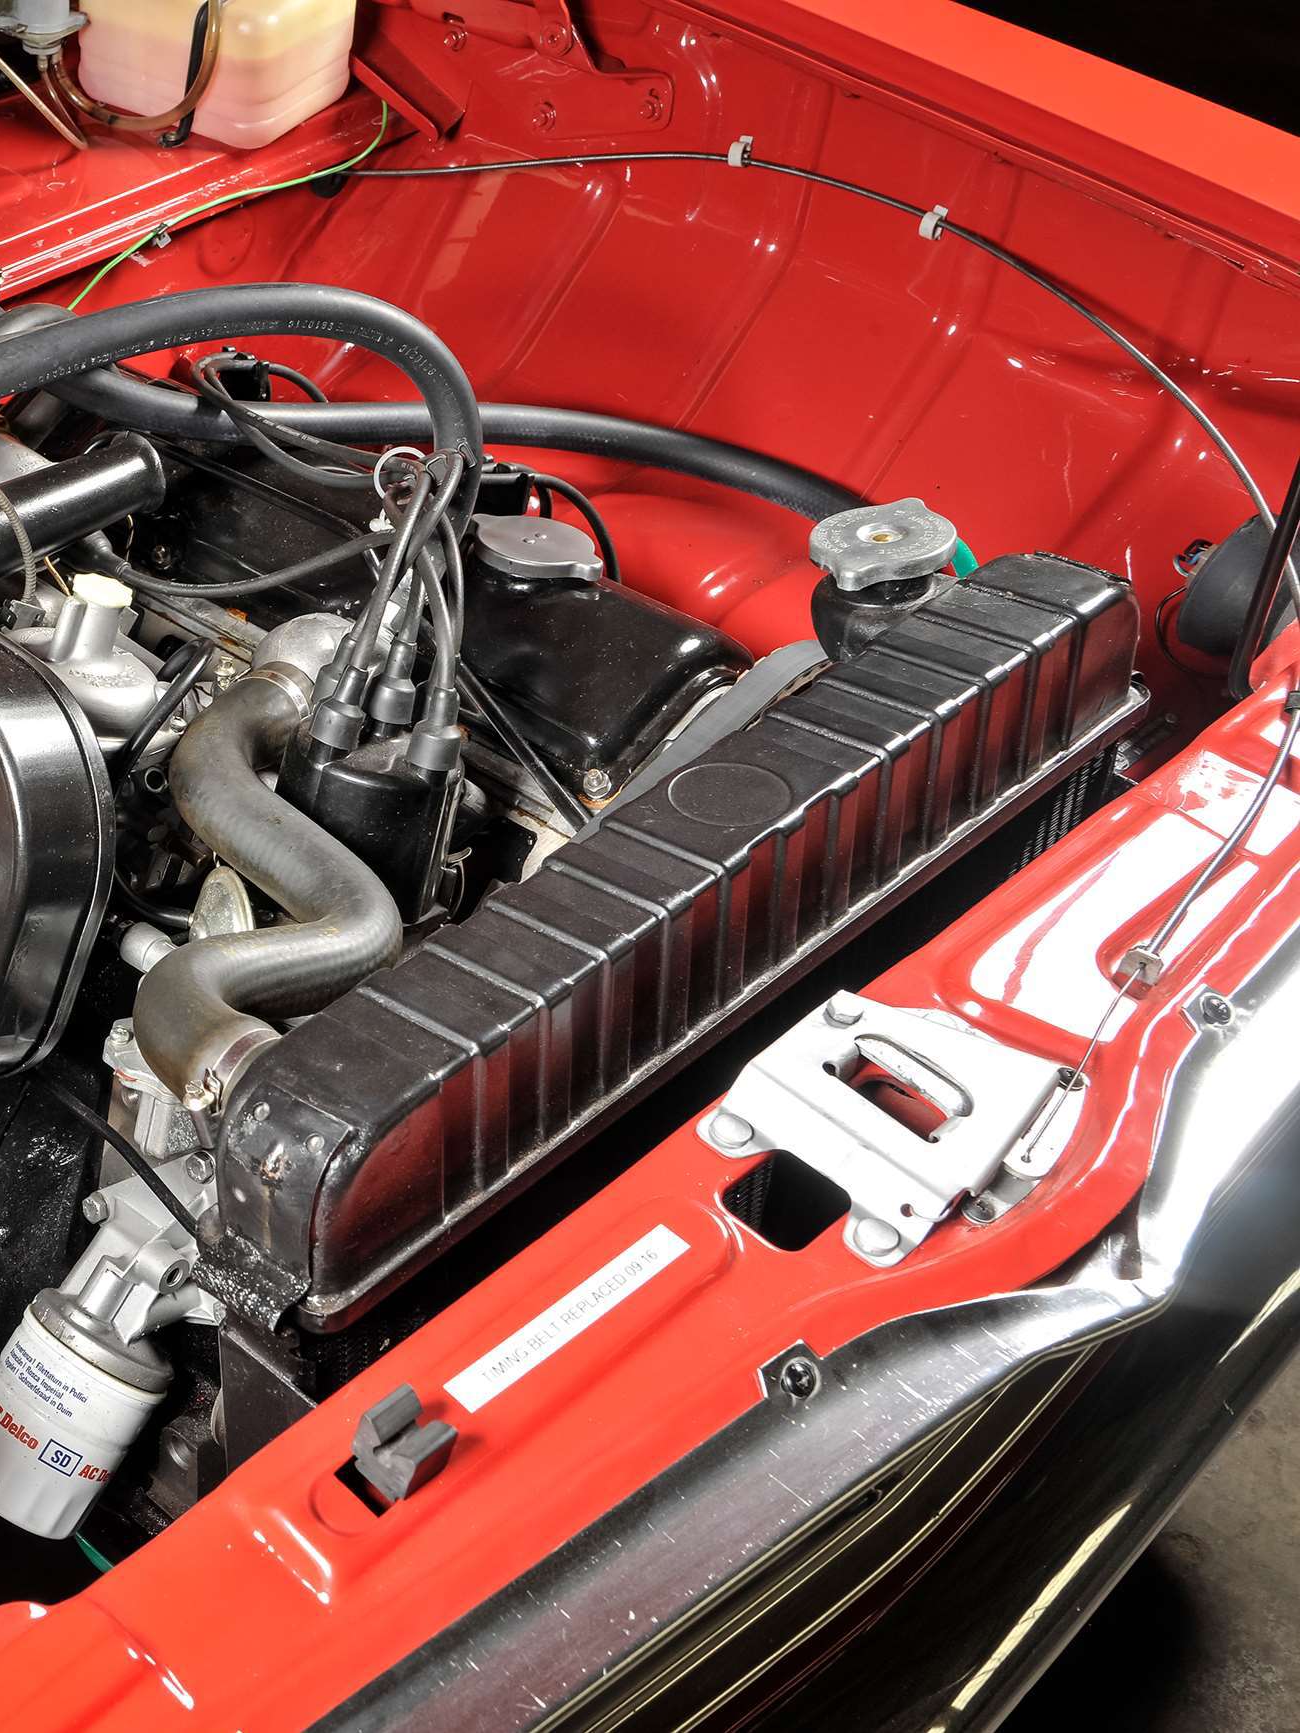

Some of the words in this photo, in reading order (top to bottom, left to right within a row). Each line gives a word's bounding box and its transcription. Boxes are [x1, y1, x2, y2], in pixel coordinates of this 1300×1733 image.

[481, 1349, 528, 1384] TIMING
[526, 1322, 562, 1351] BELT
[560, 1274, 627, 1324] REPLACED
[25, 1366, 41, 1382] Rosca
[40, 1379, 64, 1400] Imperial
[56, 1402, 73, 1418] Duim
[0, 1412, 39, 1450] Delco
[50, 1449, 72, 1468] SD
[78, 1464, 99, 1480] AC
